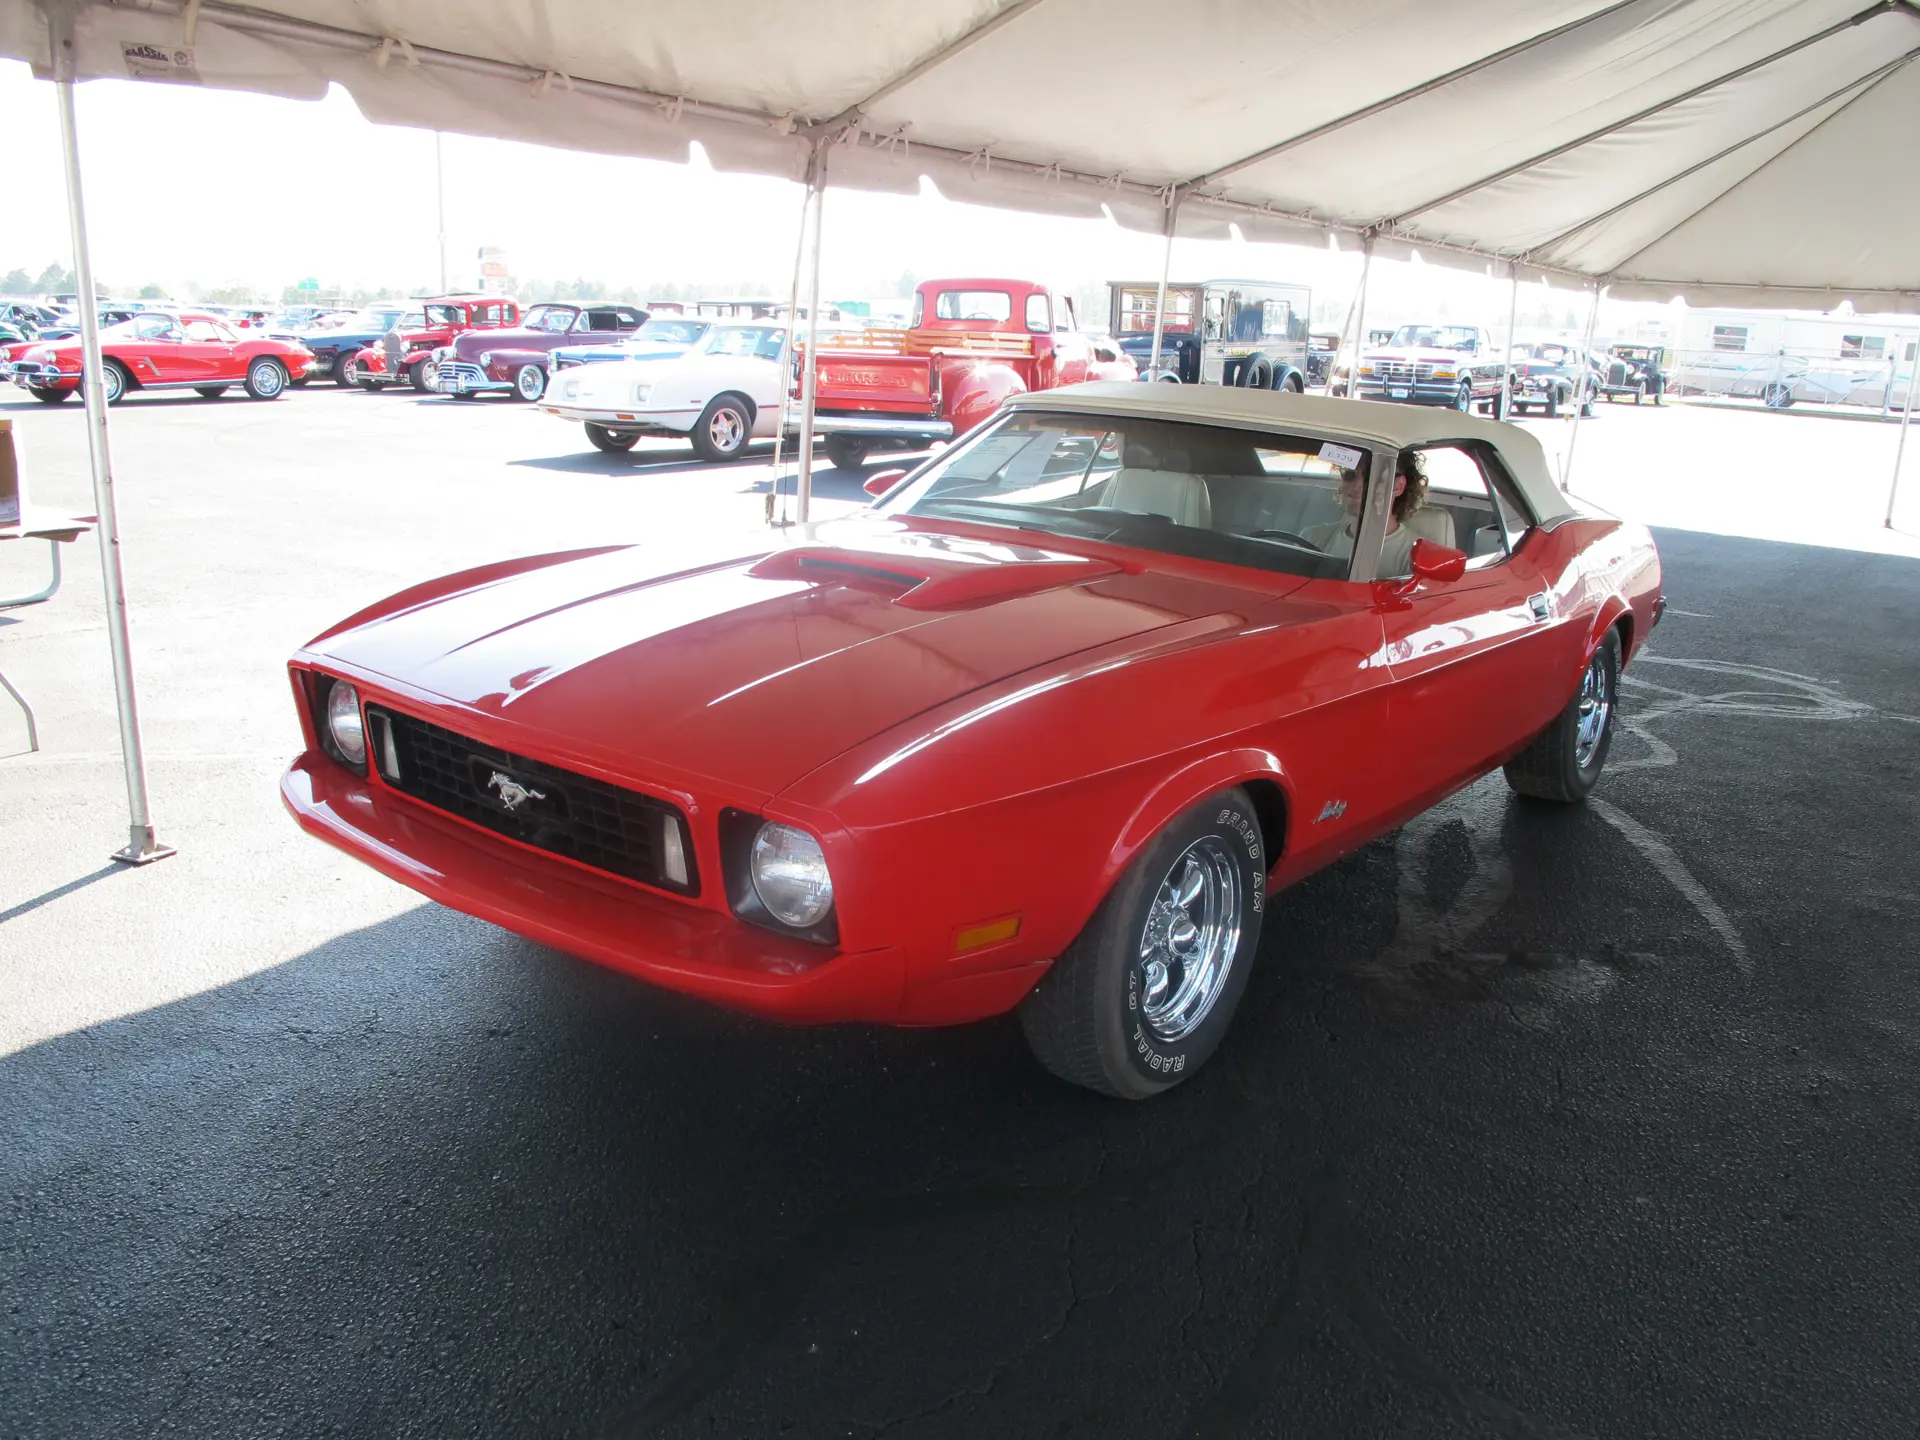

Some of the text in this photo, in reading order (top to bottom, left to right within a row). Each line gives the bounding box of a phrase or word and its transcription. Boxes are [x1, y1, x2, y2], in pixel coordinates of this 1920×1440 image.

[1216, 809, 1263, 913] GRAND AM
[1133, 1023, 1186, 1073] RADIAL
